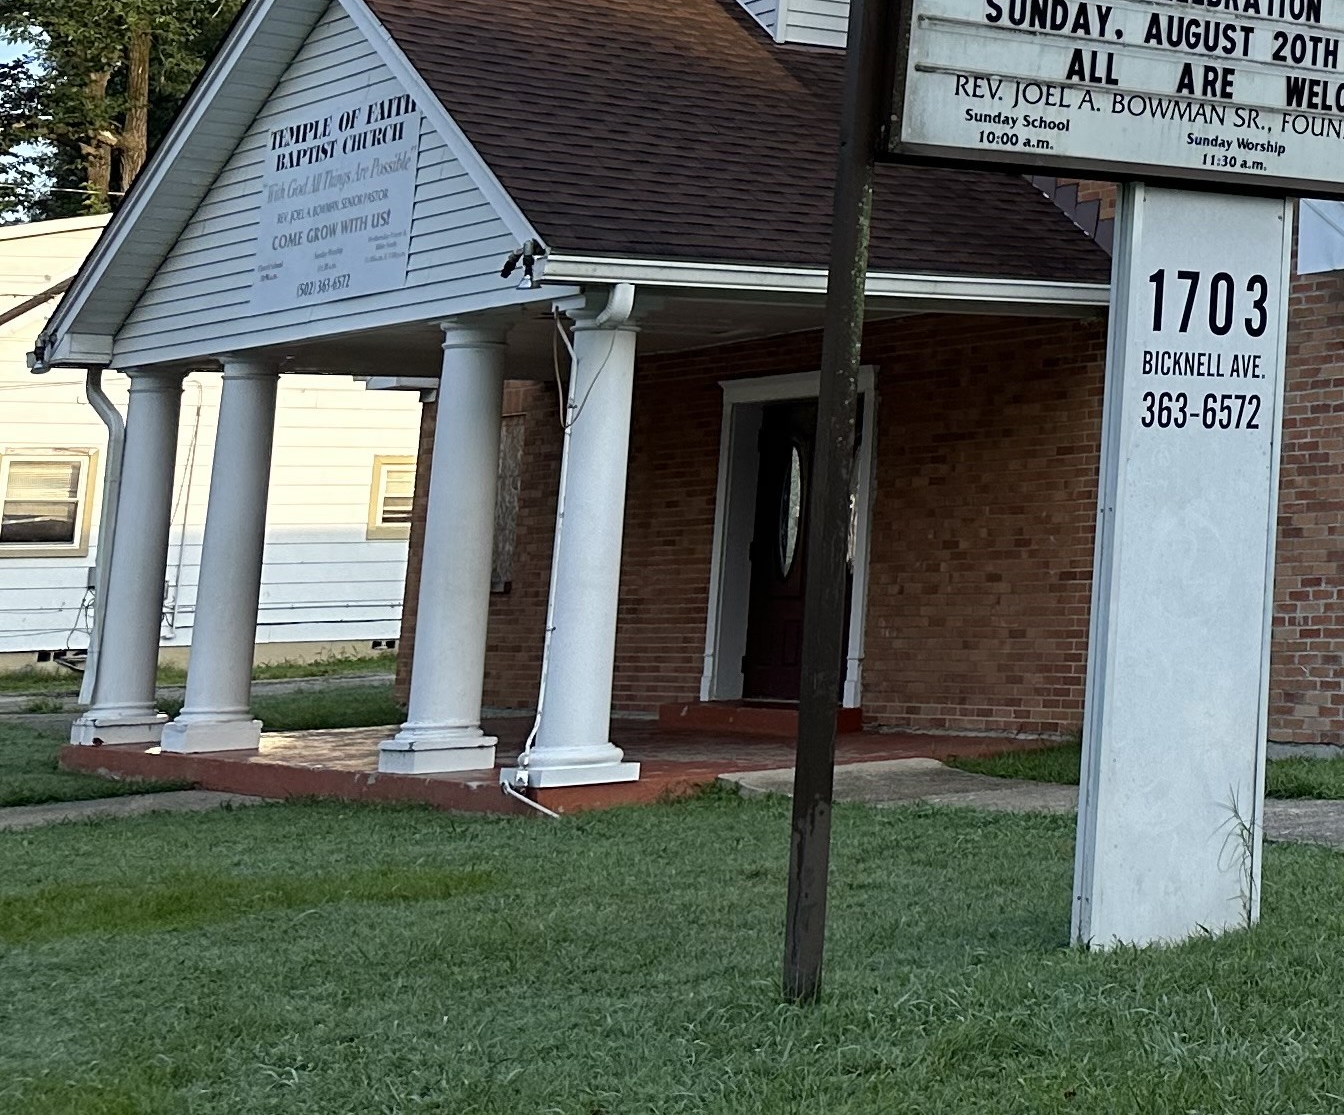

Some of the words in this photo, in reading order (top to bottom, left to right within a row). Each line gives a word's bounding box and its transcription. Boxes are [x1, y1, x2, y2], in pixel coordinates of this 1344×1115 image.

[1144, 13, 1254, 57] AUGUST
[1272, 31, 1338, 69] 20TH
[1065, 48, 1119, 85] ALL
[1176, 62, 1235, 99] ARE
[271, 115, 332, 151] TEMPLE
[338, 107, 361, 132] OF
[366, 93, 416, 125] FAITH
[955, 74, 1003, 101] REV.
[1012, 80, 1071, 109] JOEL
[1078, 89, 1101, 112] A.
[1111, 93, 1226, 126] BOWMAN
[1233, 107, 1272, 133] SR.,
[965, 109, 1018, 129] Sunday
[1022, 114, 1070, 132] School
[276, 139, 337, 172] BAPTIST
[342, 121, 405, 155] CHURCH
[979, 130, 1018, 146] 10:00
[1023, 138, 1054, 150] a.m.
[1187, 132, 1233, 151] Sunday
[1236, 137, 1286, 157] Worship
[1202, 153, 1236, 167] 11:30
[1240, 159, 1267, 171] a.m.
[272, 231, 303, 251] COME
[306, 222, 338, 243] GROW
[341, 214, 368, 235] WITH
[371, 208, 391, 229] US!
[296, 280, 316, 299] (502)
[1149, 268, 1268, 338] 1703
[1142, 350, 1225, 378] BICKNELL
[1229, 354, 1266, 380] AVE.
[1141, 391, 1262, 430] 363-6572
